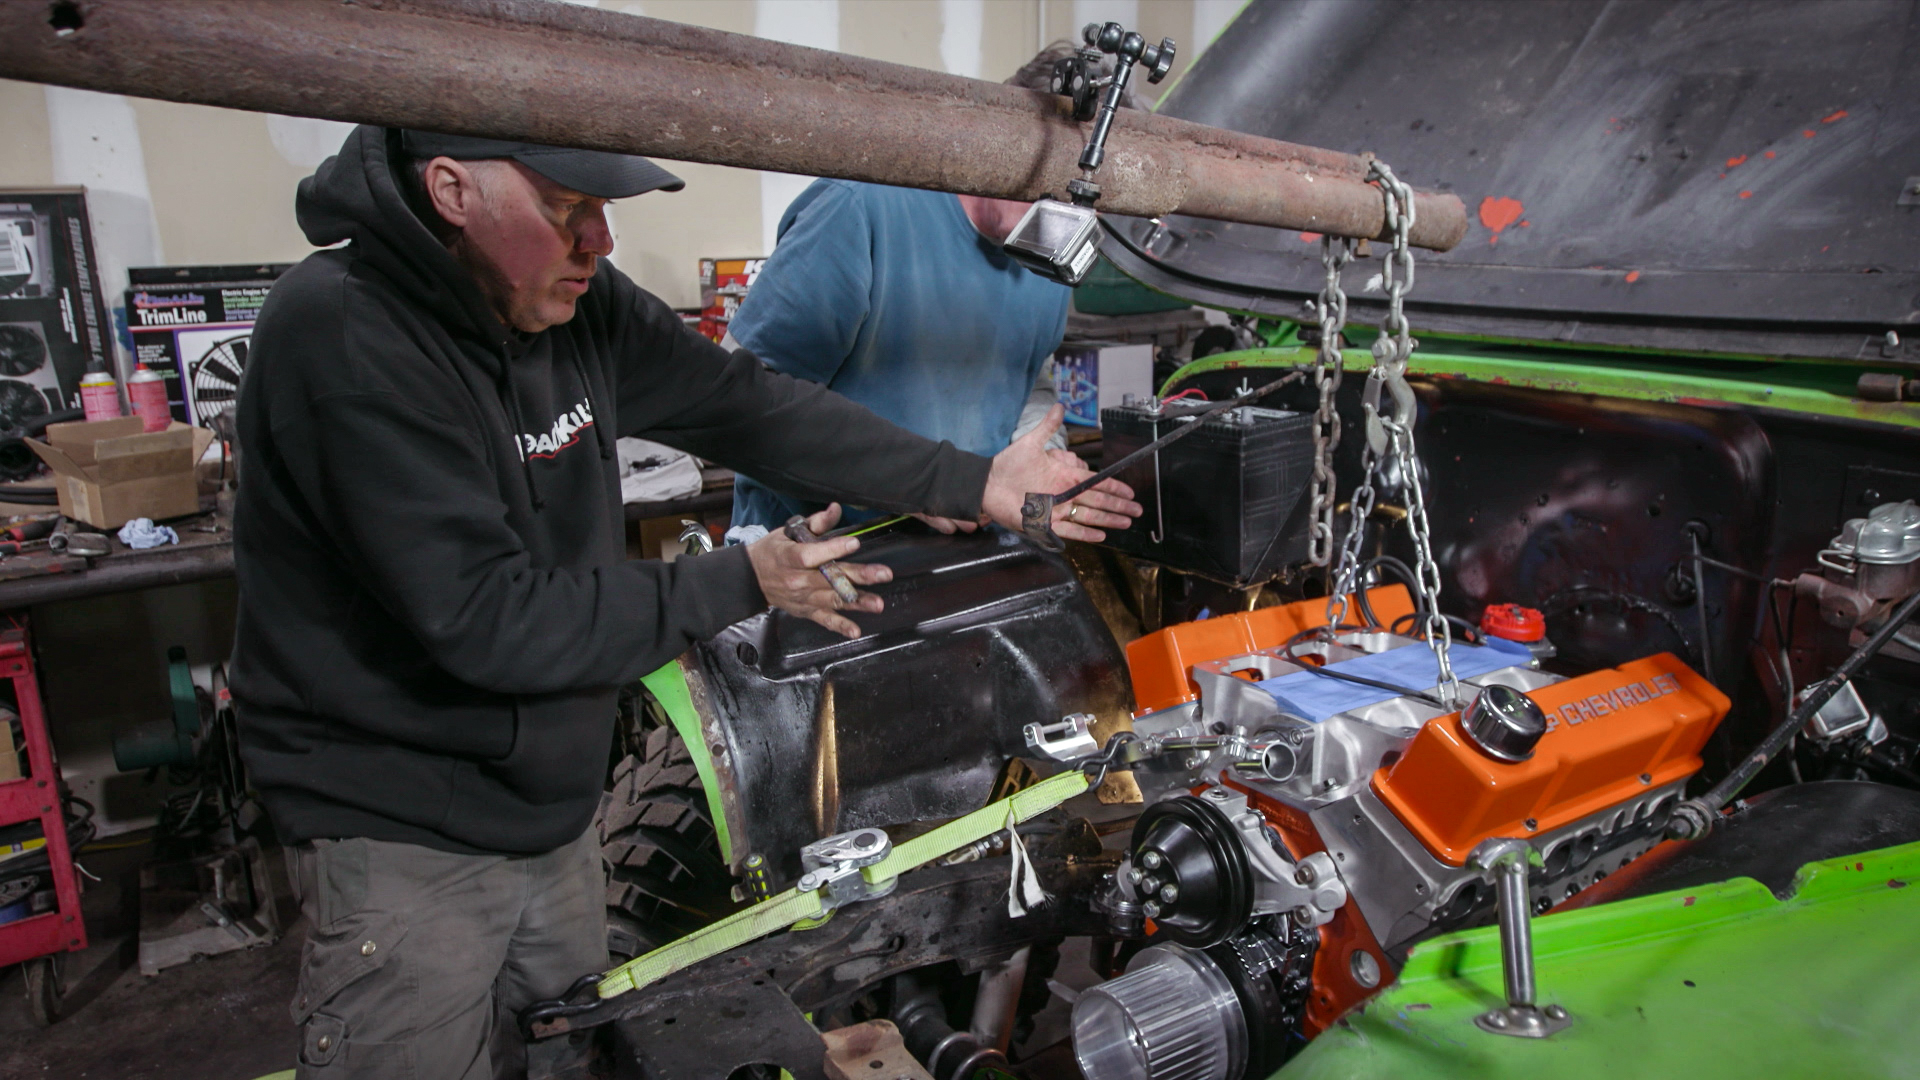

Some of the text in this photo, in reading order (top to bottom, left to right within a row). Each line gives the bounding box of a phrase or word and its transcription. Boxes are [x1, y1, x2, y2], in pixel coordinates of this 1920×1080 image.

[68, 217, 91, 290] TEMPERATURES
[81, 291, 97, 325] ENGINE
[136, 307, 207, 326] TrimLine
[1559, 672, 1682, 725] CHEVROLET
